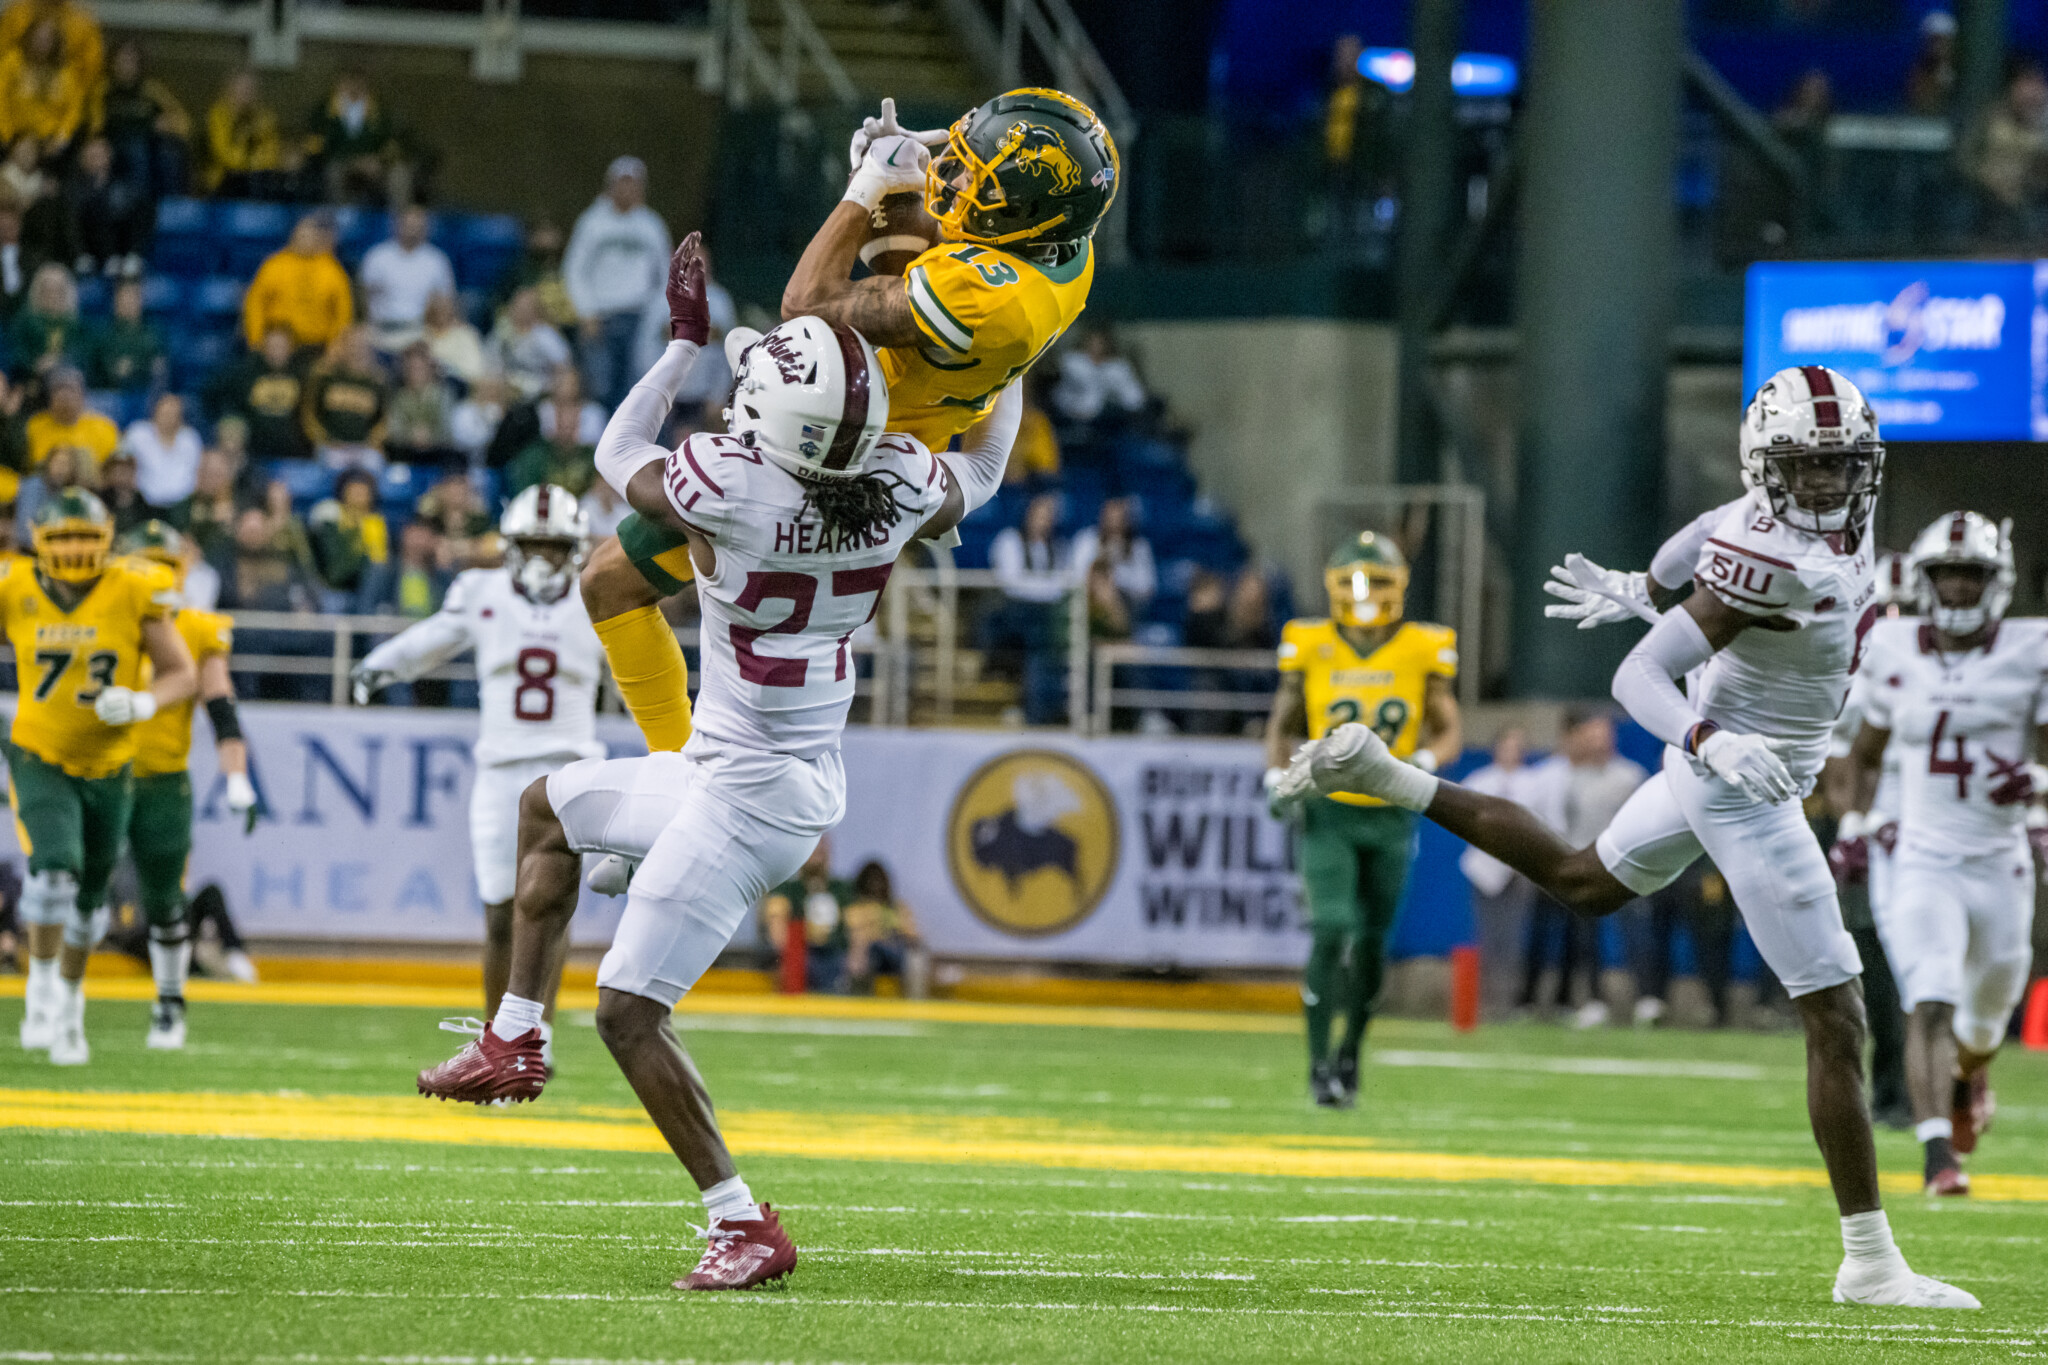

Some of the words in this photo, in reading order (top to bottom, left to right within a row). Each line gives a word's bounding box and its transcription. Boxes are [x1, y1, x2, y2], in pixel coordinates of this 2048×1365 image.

[946, 243, 1020, 288] 13
[1819, 429, 1841, 438] SIU
[665, 452, 703, 513] SIU
[796, 466, 848, 485] DAW
[773, 521, 890, 555] HEARNS
[1711, 551, 1774, 596] SIU
[728, 561, 896, 688] 27
[33, 648, 119, 706] 73
[514, 647, 558, 723] 8
[1928, 709, 1975, 800] 4
[250, 862, 484, 913] HEA
